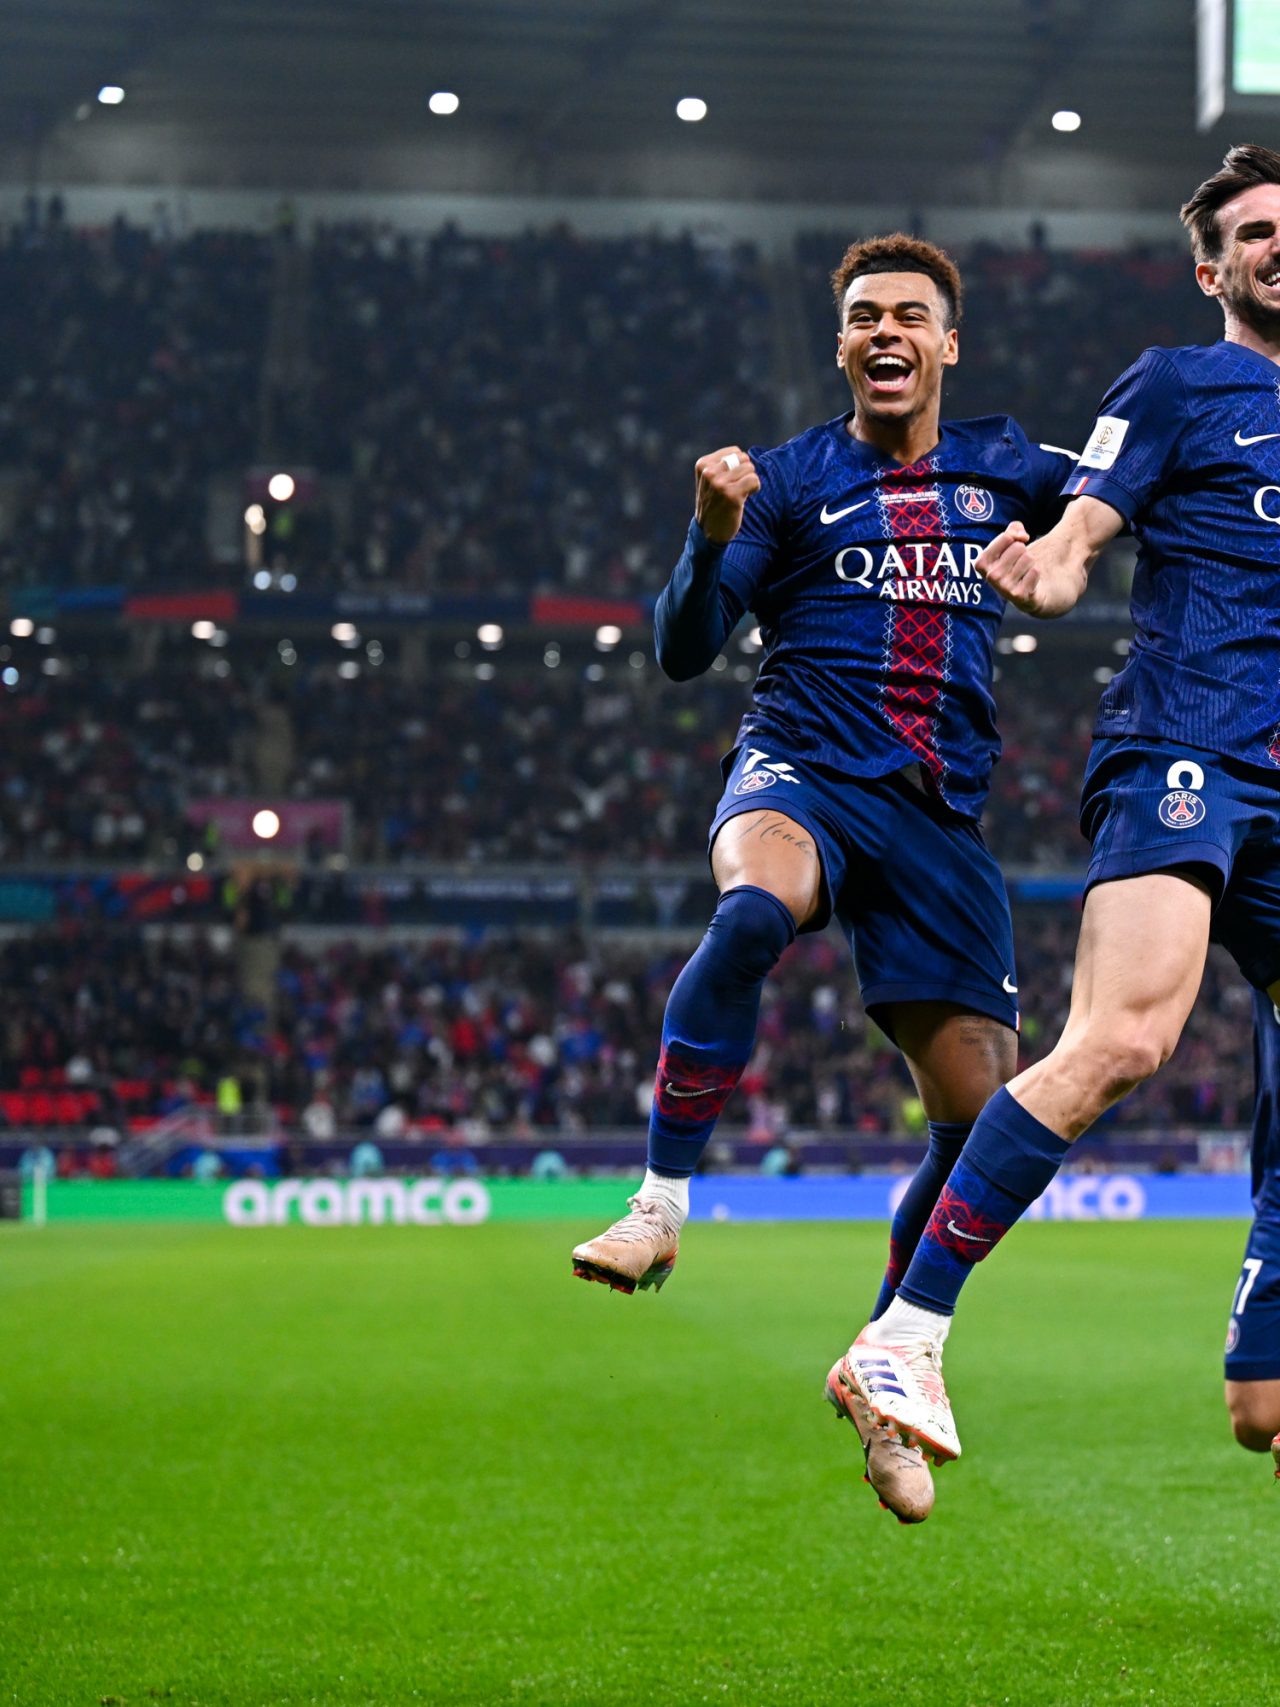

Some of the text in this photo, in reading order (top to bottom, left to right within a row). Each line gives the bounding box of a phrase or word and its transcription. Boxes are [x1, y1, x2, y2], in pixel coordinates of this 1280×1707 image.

[834, 542, 985, 589] QATAR
[879, 579, 982, 605] AIRWAYS
[1167, 792, 1198, 804] PARIS
[223, 1178, 491, 1227] aramco
